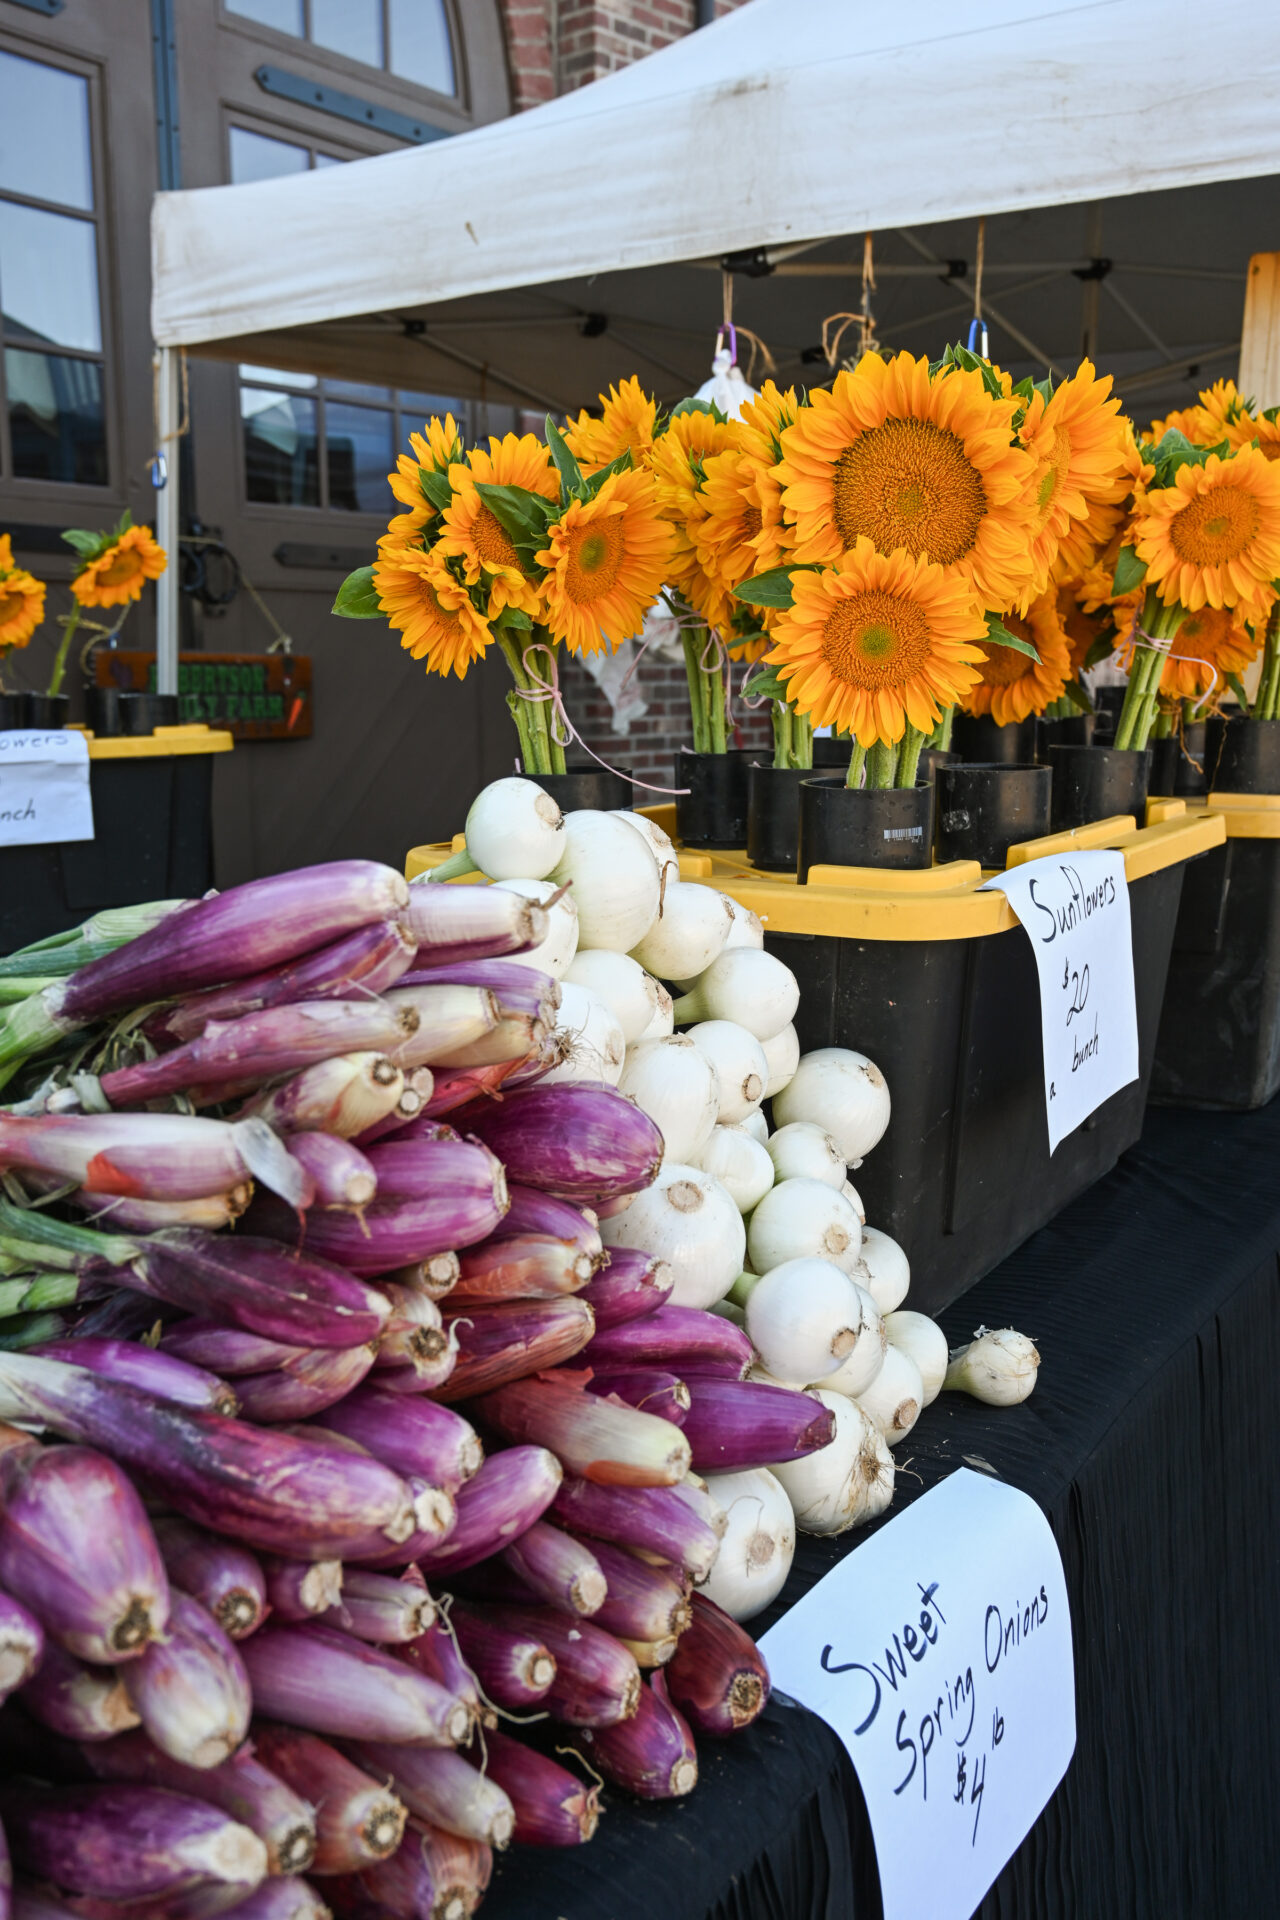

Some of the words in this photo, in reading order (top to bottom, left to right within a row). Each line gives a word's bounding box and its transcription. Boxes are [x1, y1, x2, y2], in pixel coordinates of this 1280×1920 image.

[148, 664, 265, 693] BERTSON
[226, 695, 284, 719] FARM
[1062, 956, 1090, 1027] $20
[1050, 1081, 1057, 1101] a
[1072, 1011, 1099, 1073] bunch
[820, 1581, 948, 1736] Sweet
[893, 1665, 976, 1801] Spring
[984, 1584, 1049, 1674] Onions
[953, 1751, 986, 1848] $4
